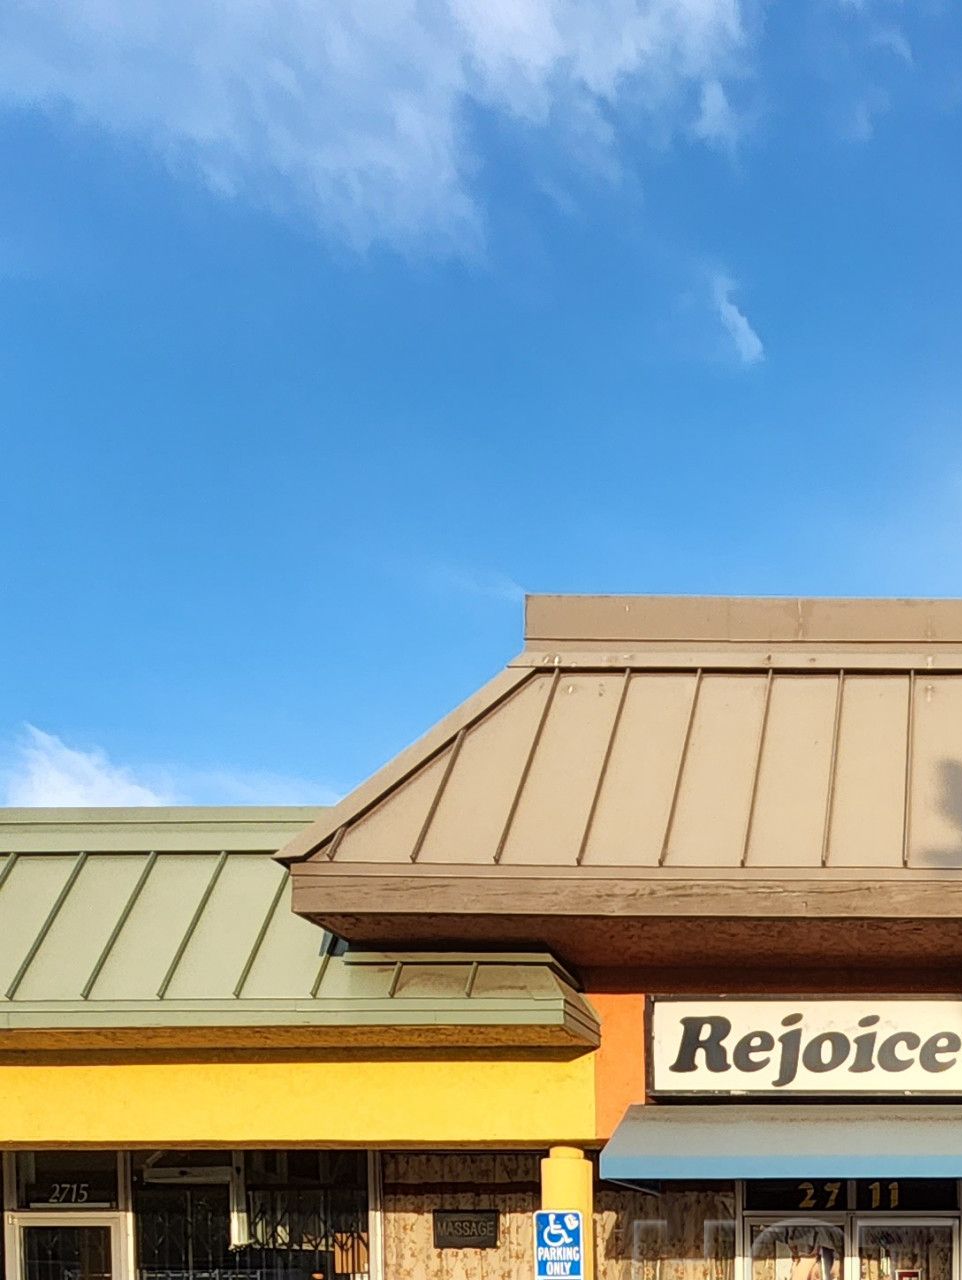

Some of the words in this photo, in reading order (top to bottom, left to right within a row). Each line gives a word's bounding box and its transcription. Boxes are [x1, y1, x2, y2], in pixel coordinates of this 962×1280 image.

[669, 1013, 962, 1087] Rejoice
[49, 1183, 89, 1203] 2715
[436, 1221, 495, 1236] MASSAGE
[537, 1246, 580, 1262] PARKING
[545, 1261, 572, 1276] ONLY
